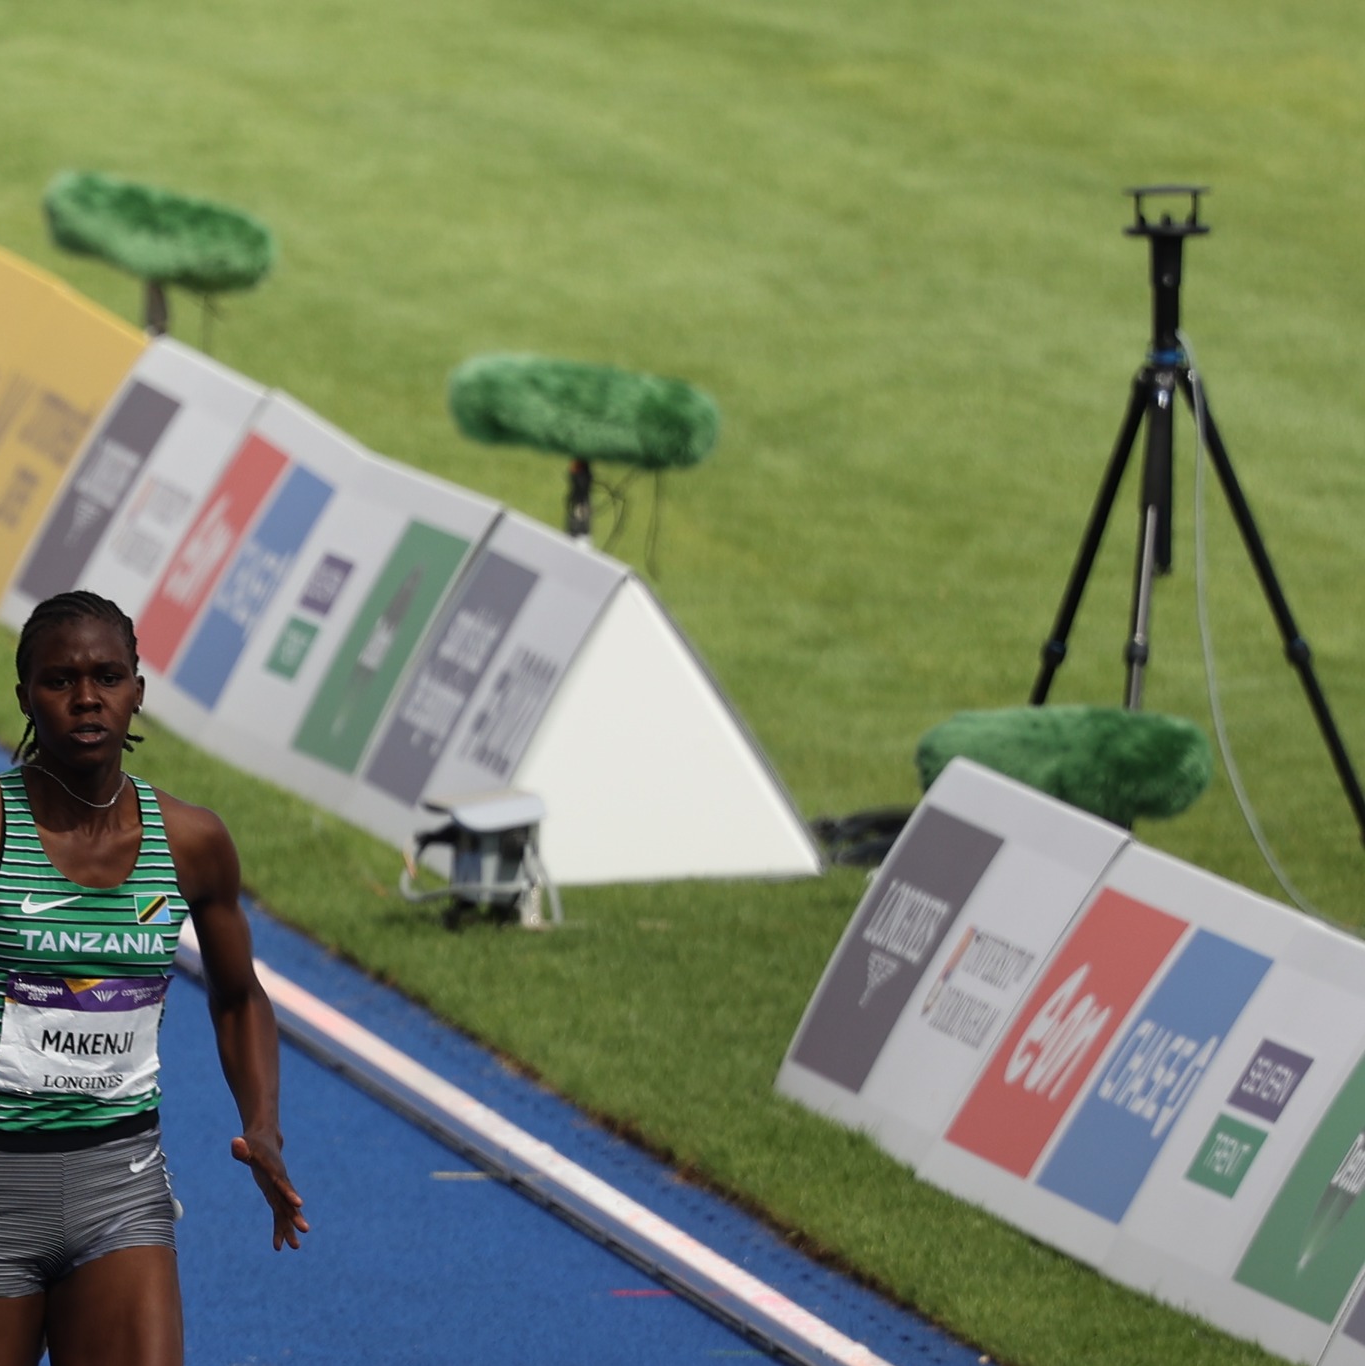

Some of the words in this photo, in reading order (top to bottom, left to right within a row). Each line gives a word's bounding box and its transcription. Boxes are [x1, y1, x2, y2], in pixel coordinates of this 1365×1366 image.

[19, 930, 166, 955] TANZANIA
[41, 1029, 134, 1055] MAKENJI
[42, 1074, 124, 1090] LONGINES
[1097, 1018, 1199, 1121] CHASE
[1240, 1055, 1297, 1106] SEVERN
[1203, 1131, 1252, 1177] TRENT
